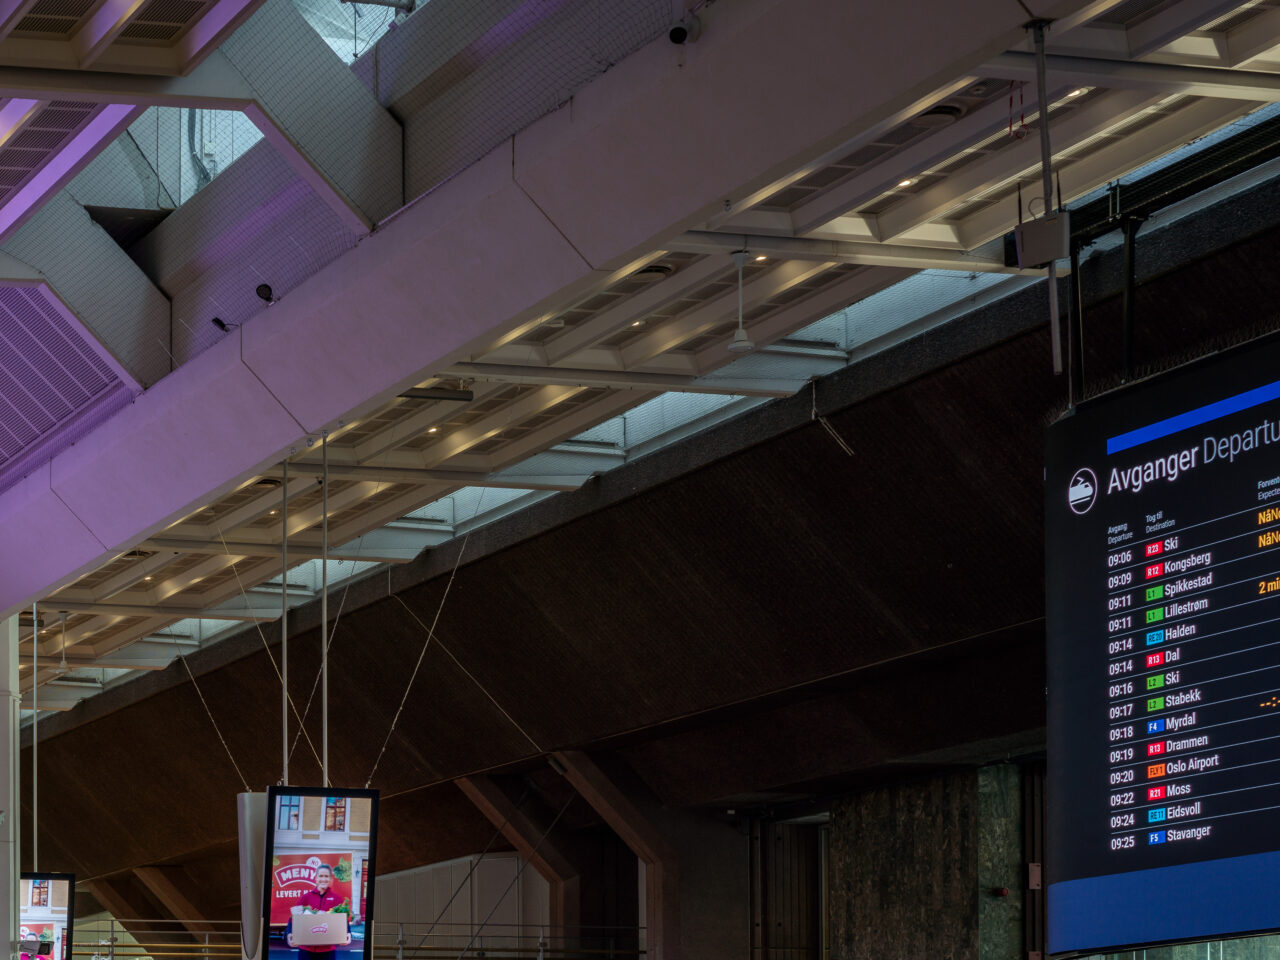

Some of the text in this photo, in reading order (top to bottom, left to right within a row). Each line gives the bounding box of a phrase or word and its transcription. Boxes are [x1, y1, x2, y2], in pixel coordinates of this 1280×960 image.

[1107, 446, 1199, 495] Avganger
[1107, 523, 1128, 535] Avgang
[1145, 514, 1156, 523] Tog
[1145, 519, 1176, 533] Destination
[1107, 532, 1133, 545] Departure
[1108, 536, 1179, 568] 09:06 R23 Ski
[1108, 551, 1211, 589] 09:09 R12 Kongsberg
[1108, 572, 1213, 611] 09:11 L1 Spikkestad
[1258, 582, 1266, 594] 2
[1108, 599, 1209, 632] 09:11 L1 Lillestrøm
[1109, 638, 1133, 654] 09:14
[1165, 624, 1197, 640] Halden
[1109, 647, 1181, 676] 09:14 R13 Dal
[1109, 670, 1180, 698] 09:16 L2 Ski
[1109, 689, 1202, 719] 09:17 L2 Stabekk
[1109, 712, 1197, 741] 09:18 F4 Myrdal
[1110, 735, 1209, 763] 09:19 R13 Drammen
[1110, 770, 1134, 785] 09:20
[1166, 761, 1187, 775] Oslo
[1188, 754, 1220, 773] Airport
[1110, 783, 1191, 807] 09:22 R21 Moss
[1111, 814, 1135, 828] 09:24
[1167, 802, 1201, 820] Eidsvoll
[1111, 825, 1212, 850] 09:25 F5 Stavanger
[280, 868, 317, 881] MENY
[276, 890, 301, 898] LEVERT
